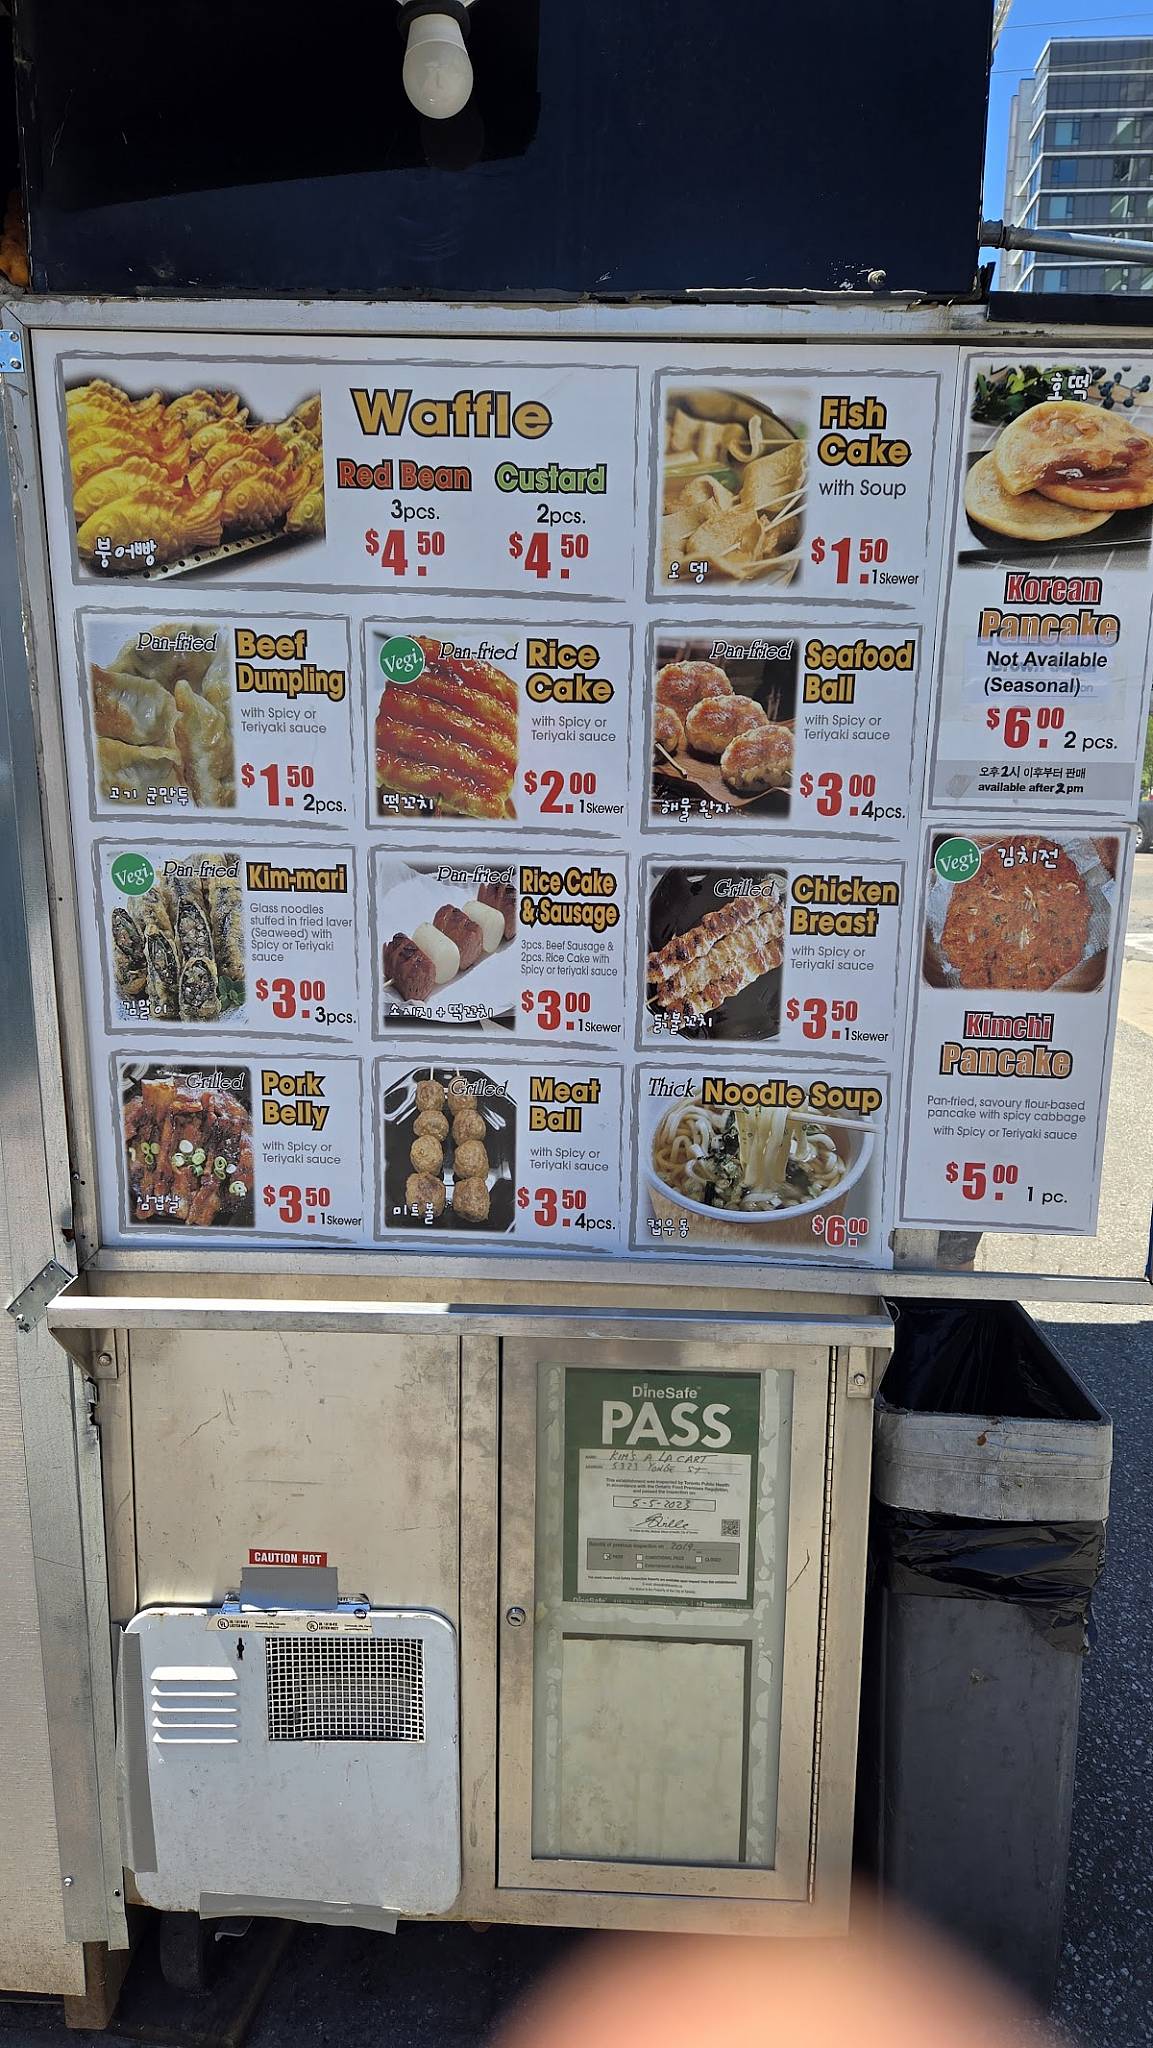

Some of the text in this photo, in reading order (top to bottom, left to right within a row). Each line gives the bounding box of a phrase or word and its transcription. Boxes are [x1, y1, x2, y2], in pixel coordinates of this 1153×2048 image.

[1047, 372, 1092, 400] 호떡
[350, 388, 553, 439] Waffle
[820, 396, 887, 429] Fish
[818, 433, 912, 467] Cake
[337, 458, 472, 491] Red Bean
[495, 461, 607, 494] Custard
[819, 480, 906, 499] with Soup
[391, 500, 440, 522] 3pcs.
[537, 504, 586, 526] 2pcs.
[95, 537, 157, 568] 붕어빵
[1004, 572, 1102, 605] Korean
[977, 608, 1120, 646] Pancake
[137, 632, 217, 652] Pan-fried
[235, 629, 307, 660] Beef
[440, 642, 519, 660] Pan-fried
[710, 639, 795, 660] Pan-fried
[383, 649, 422, 673] Vegi.
[526, 638, 600, 670] Rice
[805, 639, 915, 670] Seafood
[987, 651, 1107, 667] Not Available
[235, 662, 345, 702] Dumpling
[526, 672, 615, 704] Cake
[803, 673, 855, 704] Ball
[984, 678, 1081, 696] (Seasonal)
[532, 716, 607, 730] with Spicy or
[532, 731, 616, 743] Teriyaki sauce
[1064, 731, 1076, 749] 2
[1083, 736, 1117, 752] pcs.
[110, 787, 188, 806] 고기 군만두
[978, 782, 1026, 792] available
[1029, 783, 1055, 792] after
[303, 794, 346, 814] 2pcs.
[383, 795, 434, 812] 떡꼬치
[661, 798, 732, 822] 해물 완자
[862, 800, 905, 821] 4pcs.
[940, 852, 979, 873] Vegi.
[998, 846, 1059, 869] 김치전
[163, 860, 240, 878] Pan-fried
[246, 862, 347, 893] Kim-mari
[437, 865, 516, 884] Pan-fried
[520, 866, 617, 896] Rice Cake
[713, 879, 775, 898] Grilled
[792, 874, 899, 906] Chicken
[250, 904, 323, 914] Glass noodles
[520, 896, 620, 933] & Sausage
[251, 916, 352, 928] stuffed in fried laver
[790, 906, 879, 937] Breast
[251, 928, 332, 940] (Seaweed) with
[251, 940, 334, 953] Spicy or Teriyaki
[546, 941, 565, 950] Beef
[567, 941, 605, 952] Sausage
[608, 942, 614, 951] &
[252, 953, 284, 962] sauce
[546, 953, 564, 963] Rice
[567, 953, 590, 963] Cake
[592, 954, 609, 964] with
[521, 965, 617, 977] Spicy or teriyaki sauce
[315, 1007, 356, 1026] 3pcs.
[389, 1004, 432, 1018] 소시지
[448, 1004, 493, 1021] 떡꼬치
[963, 1011, 1054, 1042] Kimchi
[939, 1042, 1073, 1079] Pancake
[186, 1072, 245, 1091] Grilled
[261, 1069, 325, 1097] Pork
[451, 1078, 508, 1097] Grilled
[530, 1077, 600, 1104] Meat
[648, 1077, 882, 1115] Thick Noodle Soup
[927, 1095, 1085, 1111] Pan-fried, savoury flour-based
[262, 1100, 330, 1131] Belly
[529, 1106, 582, 1132] Ball
[927, 1109, 1086, 1125] pancake with spicy cabbage
[933, 1126, 1077, 1140] with Spicy or Teriyaki sauce
[137, 1195, 181, 1215] 삼겹살
[1028, 1186, 1034, 1201] 1
[1042, 1192, 1067, 1205] pc.
[575, 1213, 616, 1232] 4pcs.
[633, 1383, 698, 1399] DineSafe
[602, 1400, 732, 1448] PASS
[255, 1552, 321, 1564] CAUTION HOT
